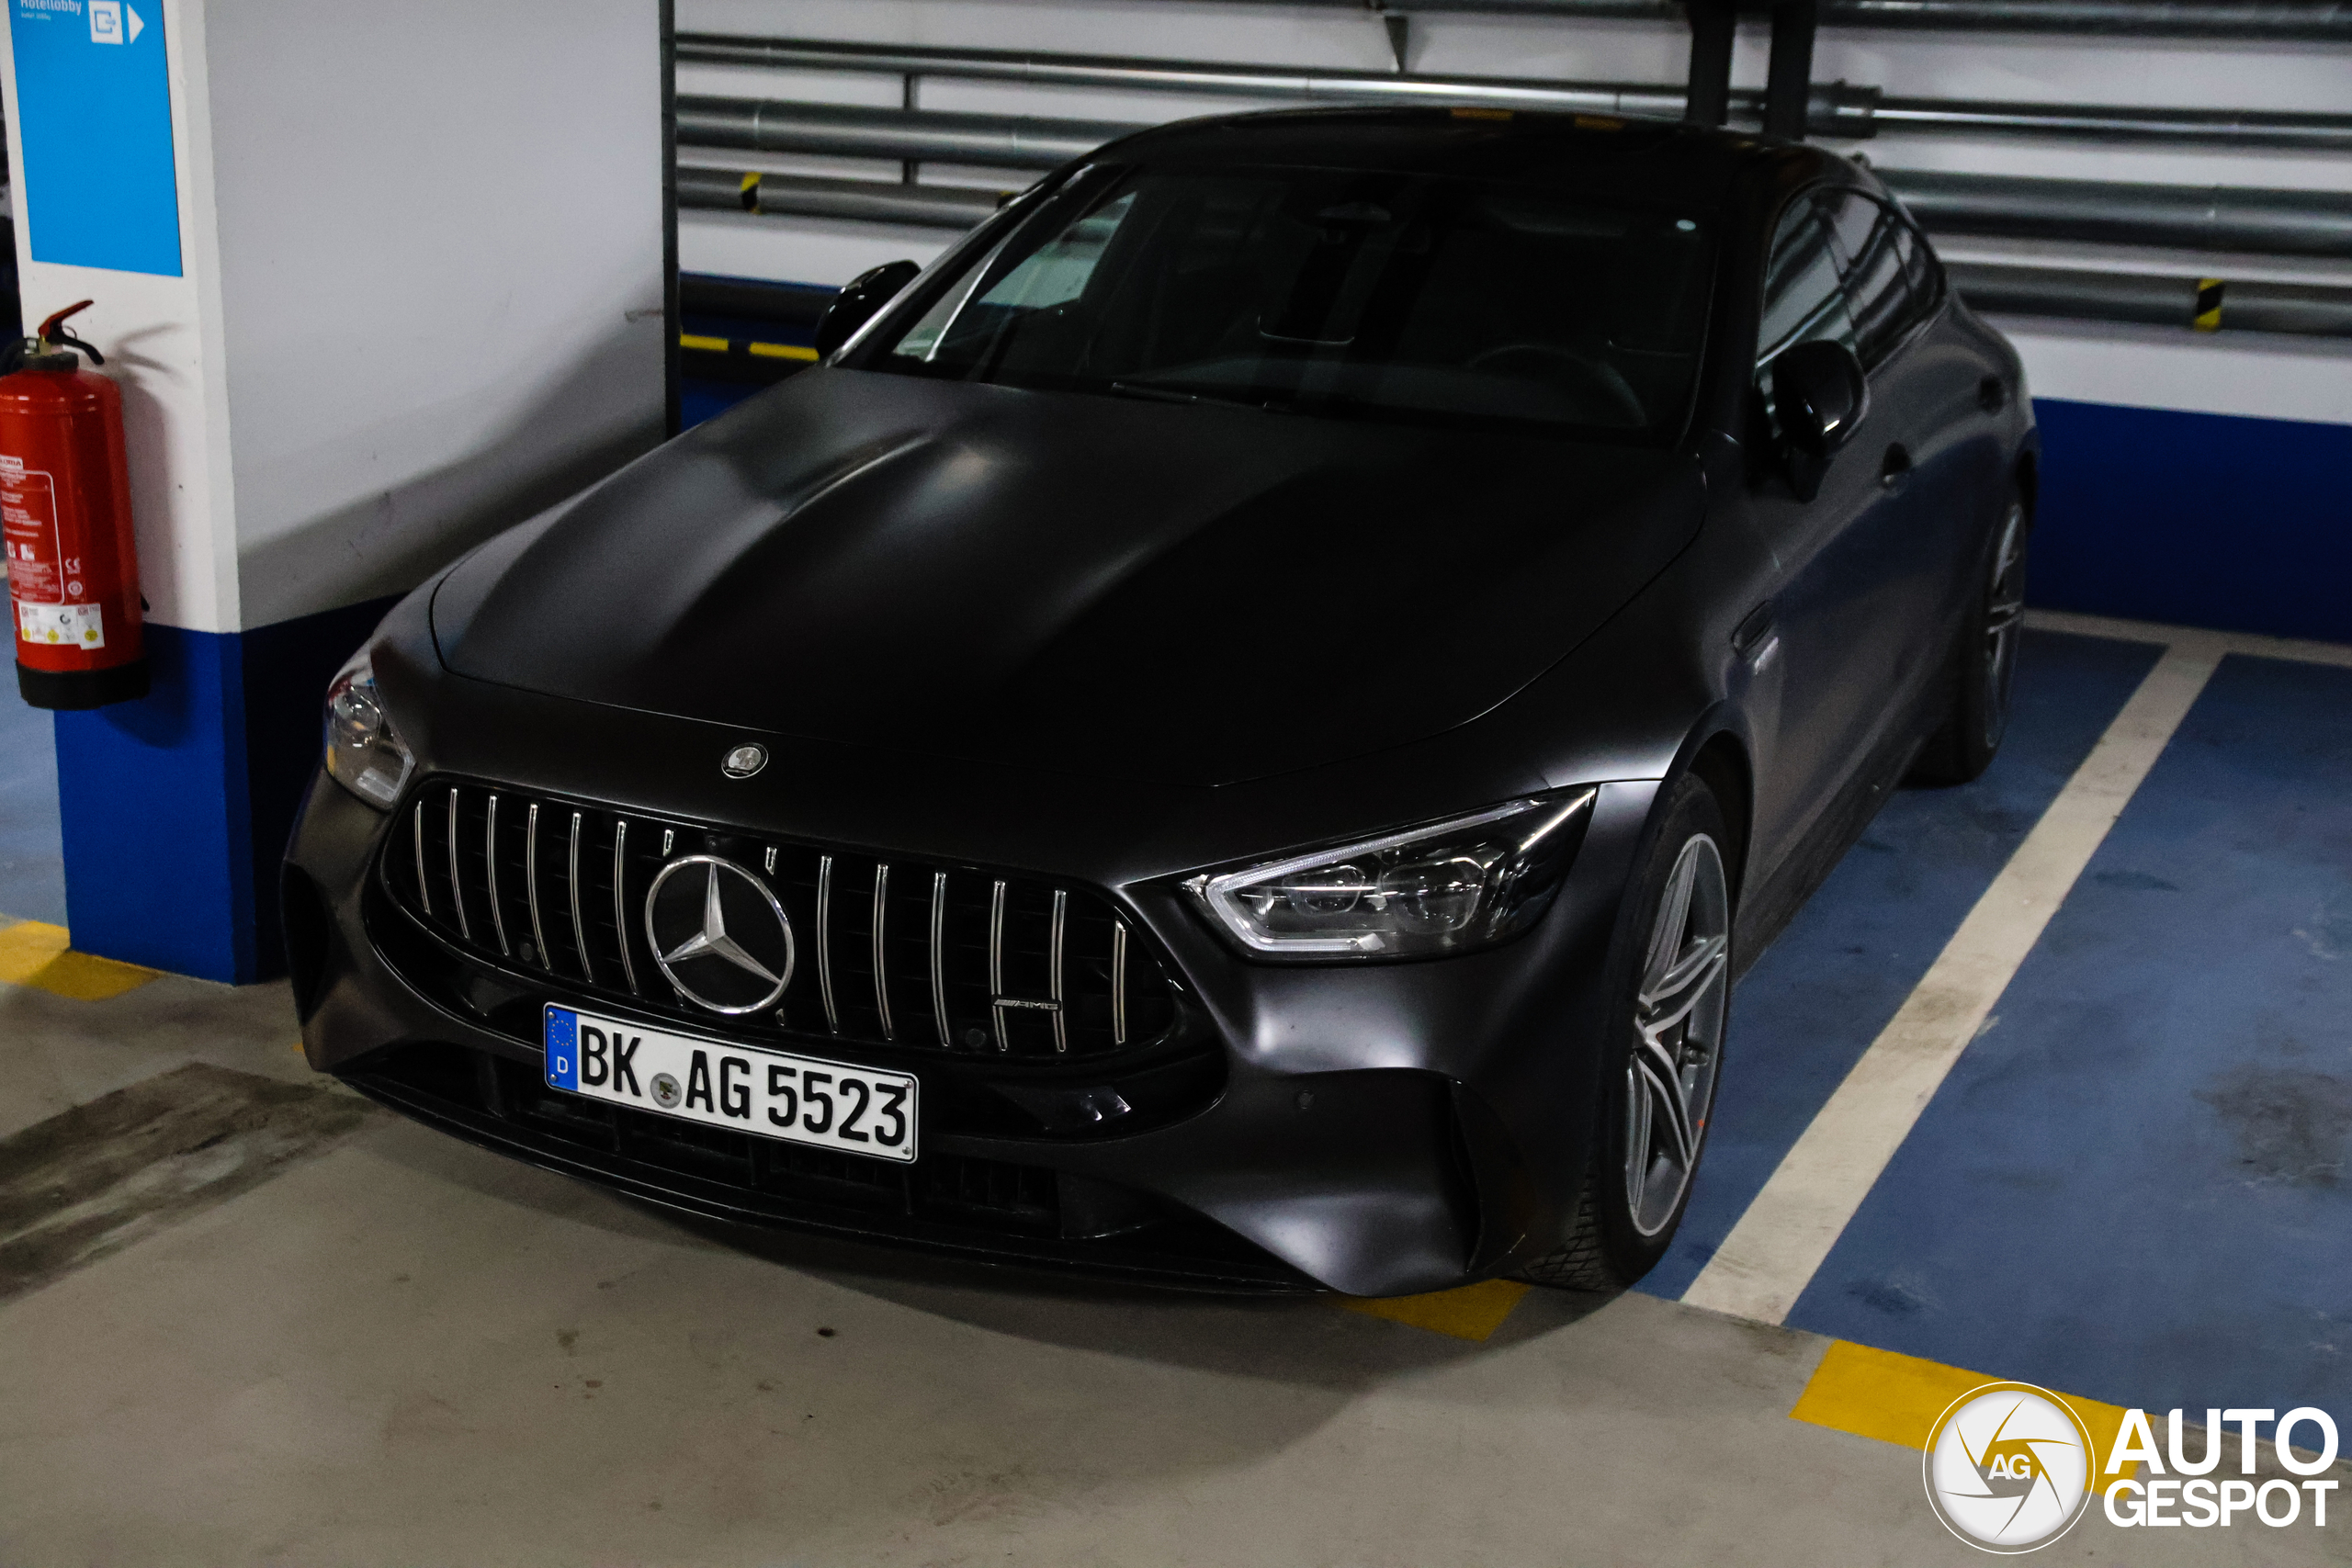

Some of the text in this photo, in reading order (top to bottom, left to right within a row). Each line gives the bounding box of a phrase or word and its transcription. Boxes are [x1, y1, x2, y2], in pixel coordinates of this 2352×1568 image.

[557, 1055, 569, 1074] D
[580, 1024, 908, 1146] BK AG 5523
